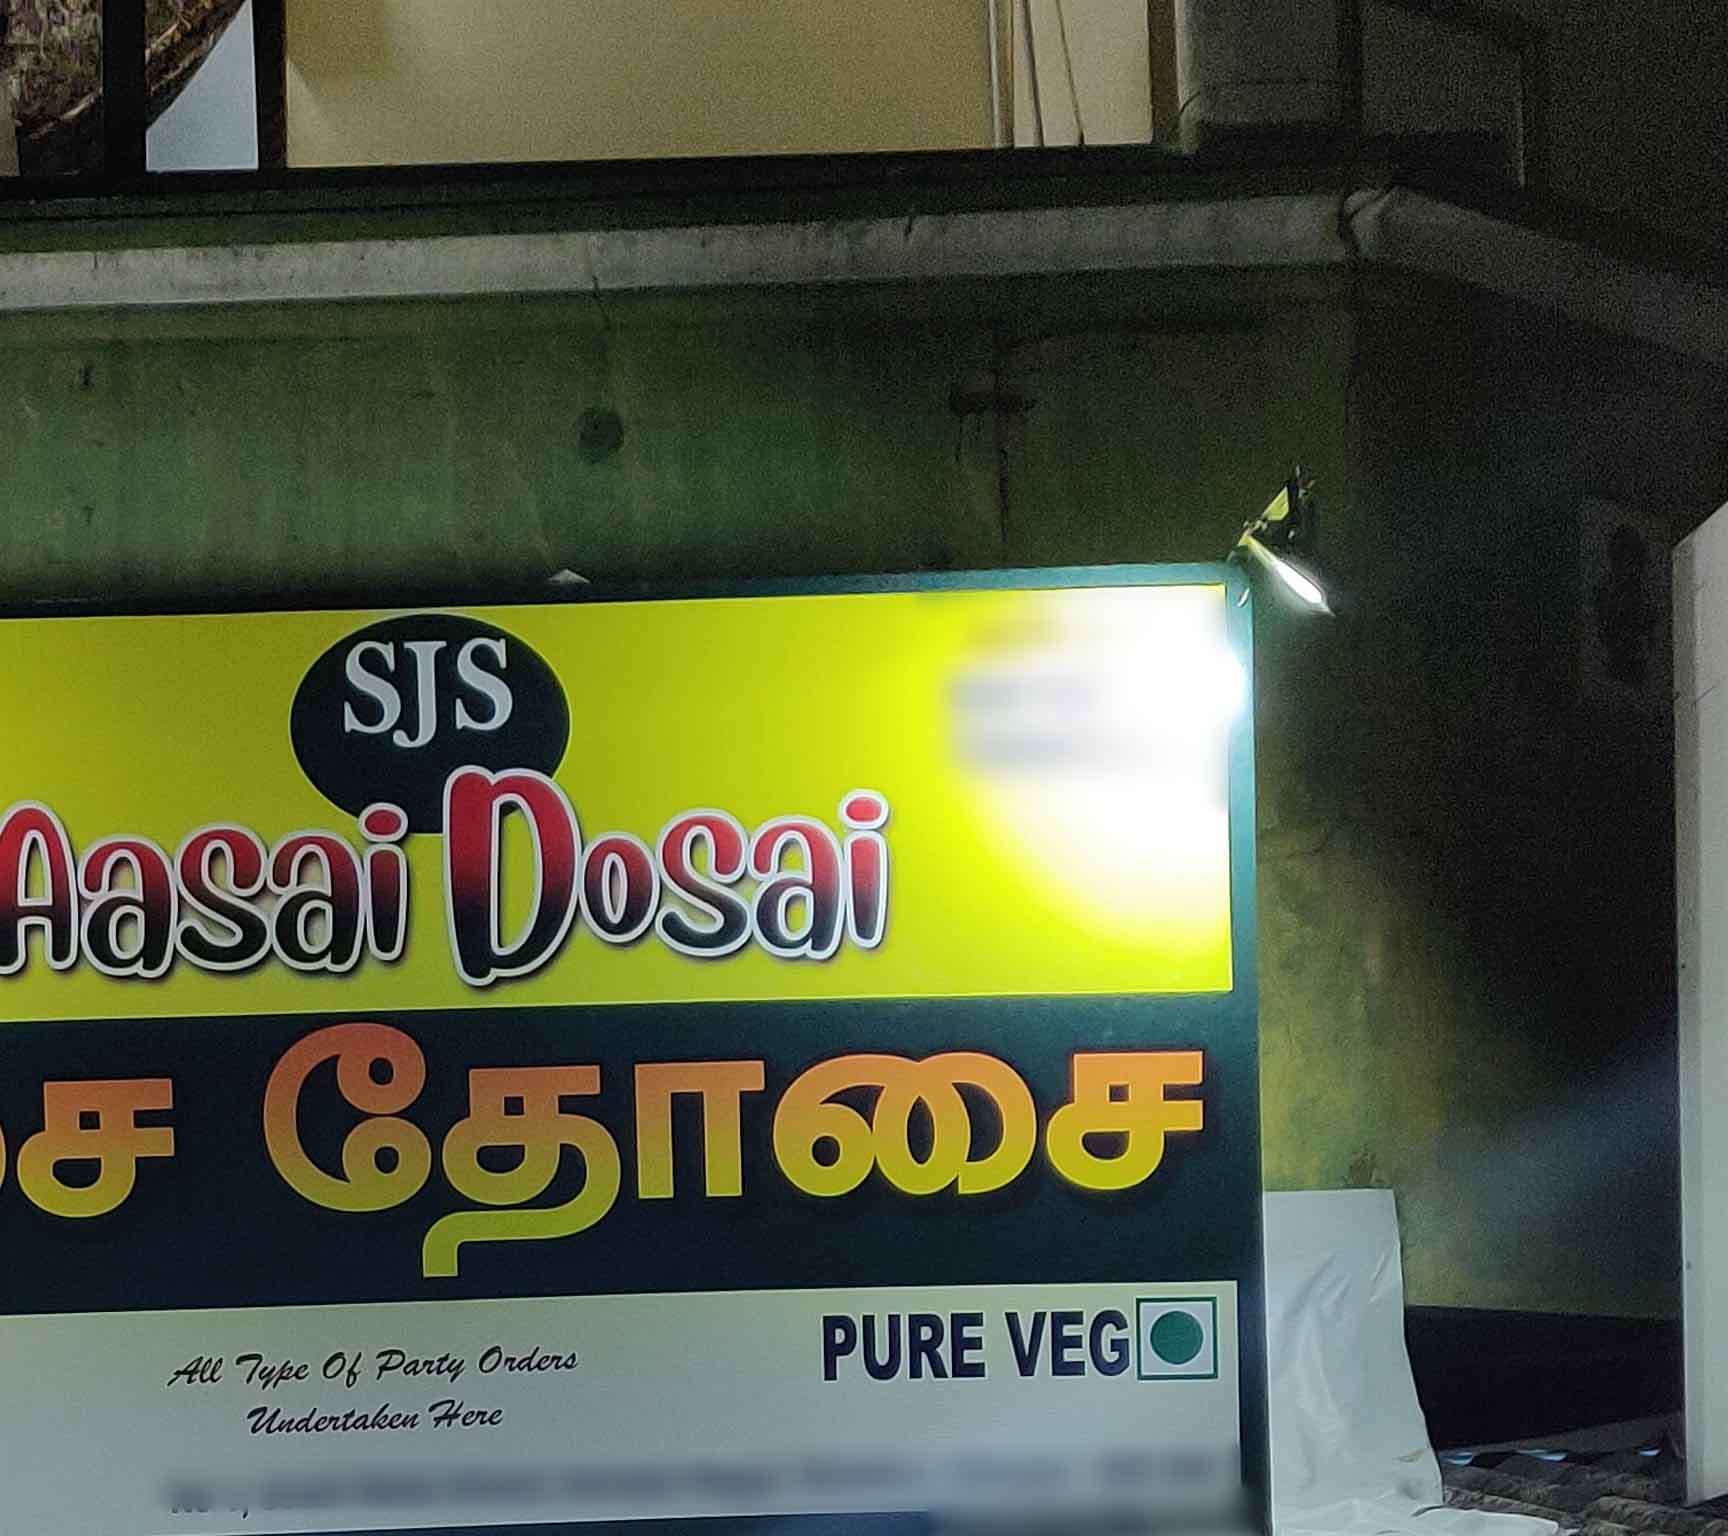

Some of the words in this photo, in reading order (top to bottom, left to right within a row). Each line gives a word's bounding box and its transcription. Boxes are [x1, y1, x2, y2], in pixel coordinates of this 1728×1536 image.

[343, 637, 513, 748] SJS
[443, 764, 891, 988] Dosai
[263, 1022, 1204, 1279] தோசை
[167, 1355, 224, 1387] All
[235, 1353, 311, 1391] Type
[322, 1350, 362, 1388] Of
[375, 1348, 466, 1383] Party
[478, 1345, 579, 1374] Orders
[822, 1312, 986, 1382] PURE
[1005, 1309, 1131, 1378] VEG
[246, 1404, 420, 1435] Undertaken
[428, 1398, 503, 1429] Here
